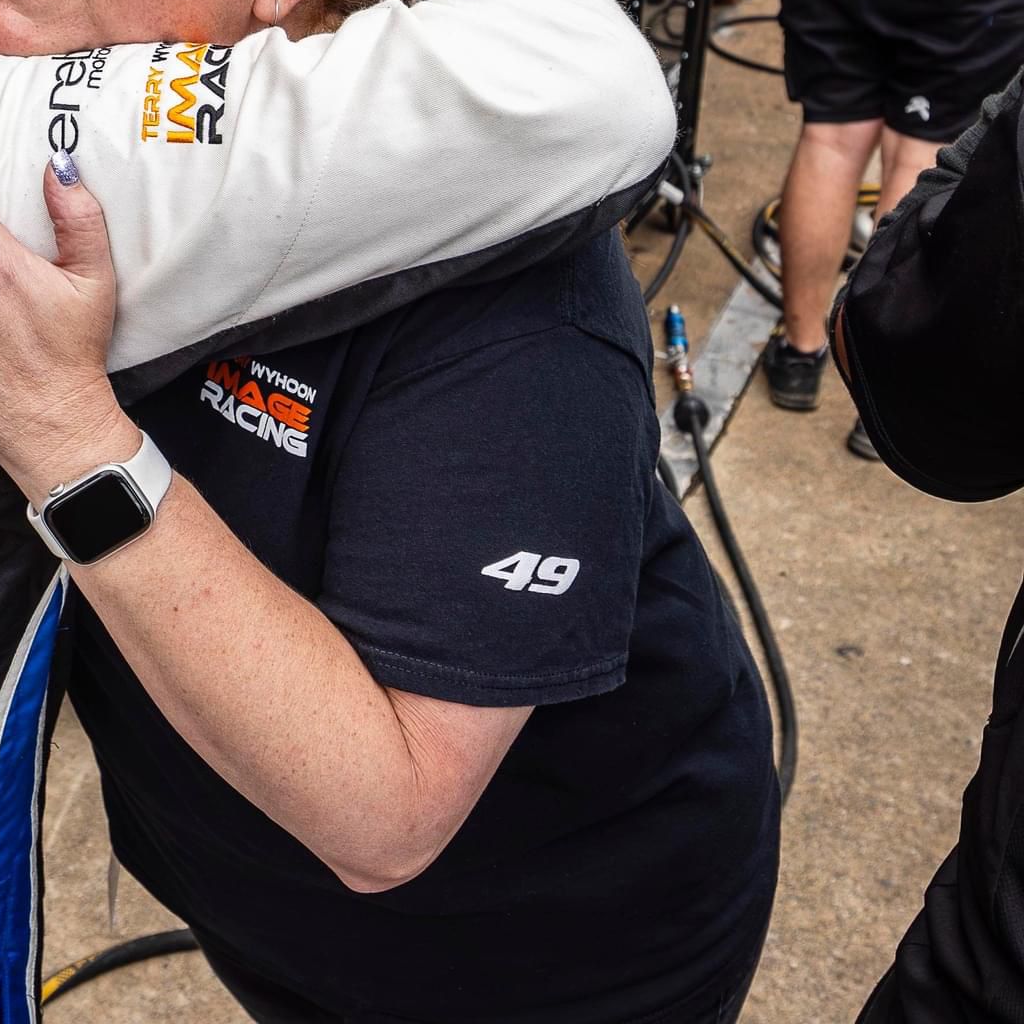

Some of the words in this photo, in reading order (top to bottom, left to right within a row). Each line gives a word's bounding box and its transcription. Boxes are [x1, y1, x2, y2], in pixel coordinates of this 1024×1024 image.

[140, 66, 166, 143] TERRY
[200, 379, 309, 458] RACING
[207, 359, 313, 433] IMAGE
[250, 360, 317, 404] WYHOON
[481, 550, 581, 596] 49
